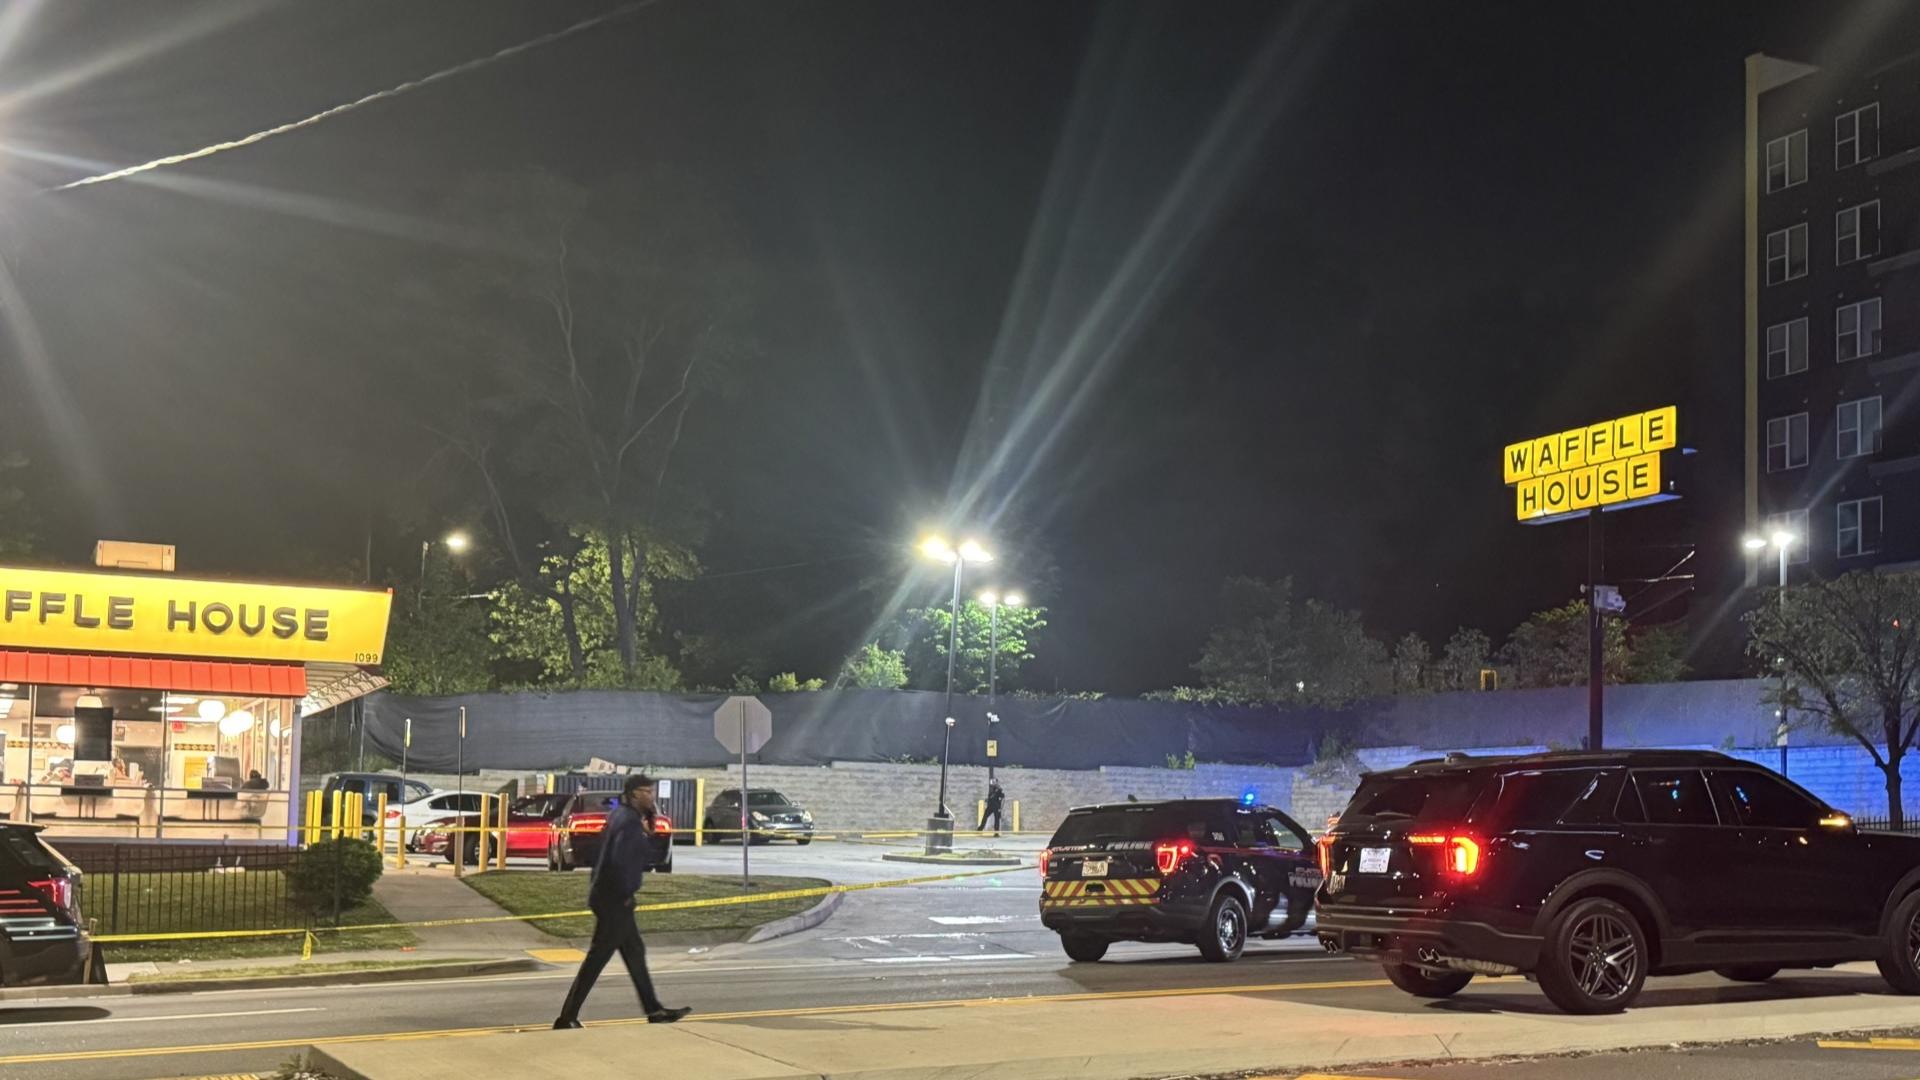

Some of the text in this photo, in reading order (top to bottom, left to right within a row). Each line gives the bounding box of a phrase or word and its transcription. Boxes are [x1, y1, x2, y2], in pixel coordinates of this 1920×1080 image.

[1510, 415, 1664, 474] WAFFLE
[1523, 462, 1649, 511] HOUSE
[4, 589, 330, 641] FFLE HOUSE
[354, 652, 379, 663] 1099
[1105, 841, 1154, 851] POLICE
